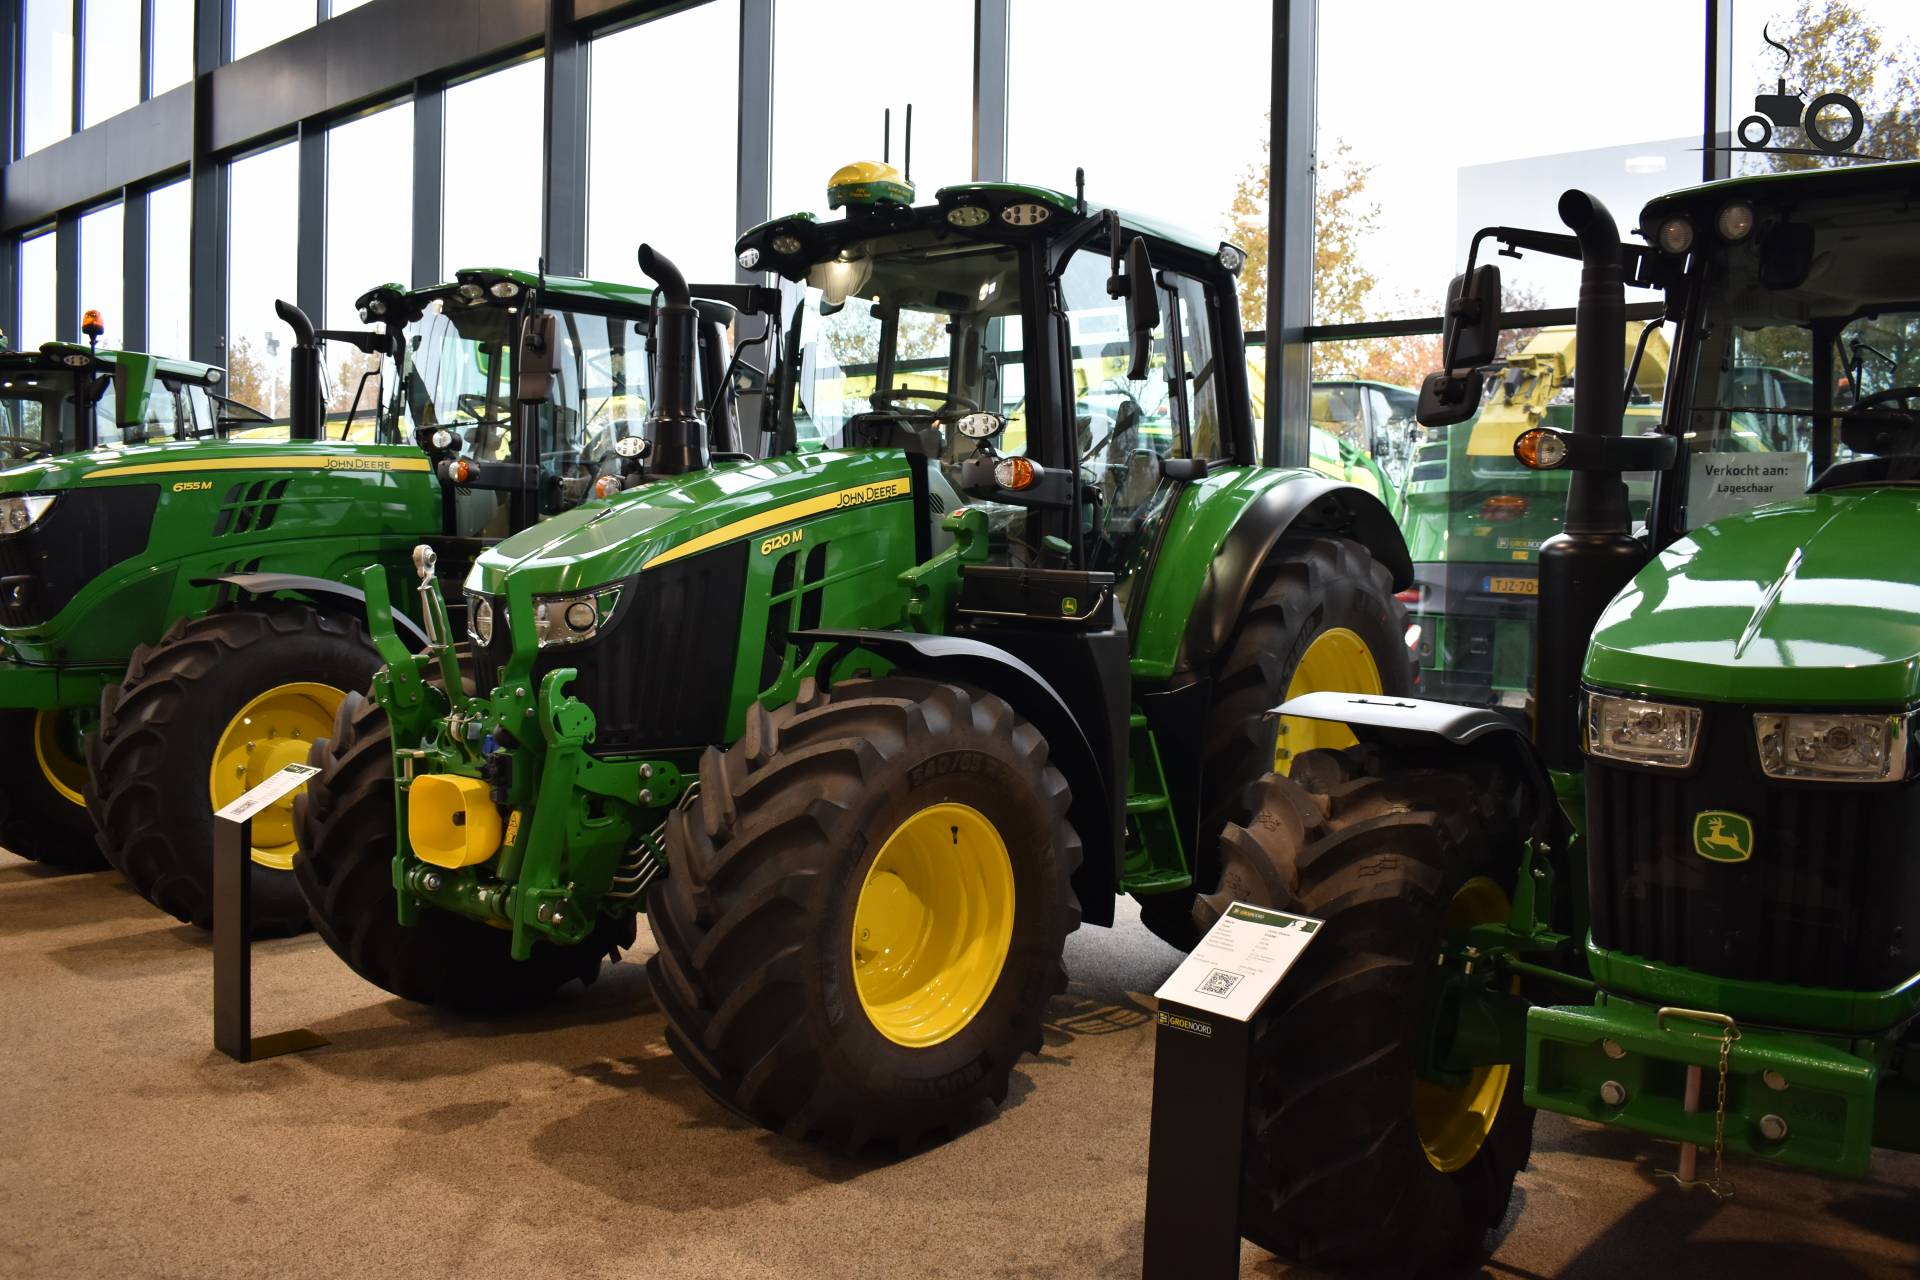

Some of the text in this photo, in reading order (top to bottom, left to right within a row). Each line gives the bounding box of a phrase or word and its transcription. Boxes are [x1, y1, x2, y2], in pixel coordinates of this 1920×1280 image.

[324, 457, 391, 469] JOHN DEERE
[1705, 464, 1789, 476] Verkocht aan:
[1717, 482, 1774, 495] Lageschaar
[837, 484, 897, 507] JOHN DEERE
[1495, 580, 1538, 593] TJZ-70-
[1169, 1016, 1212, 1035] GROENOORD
